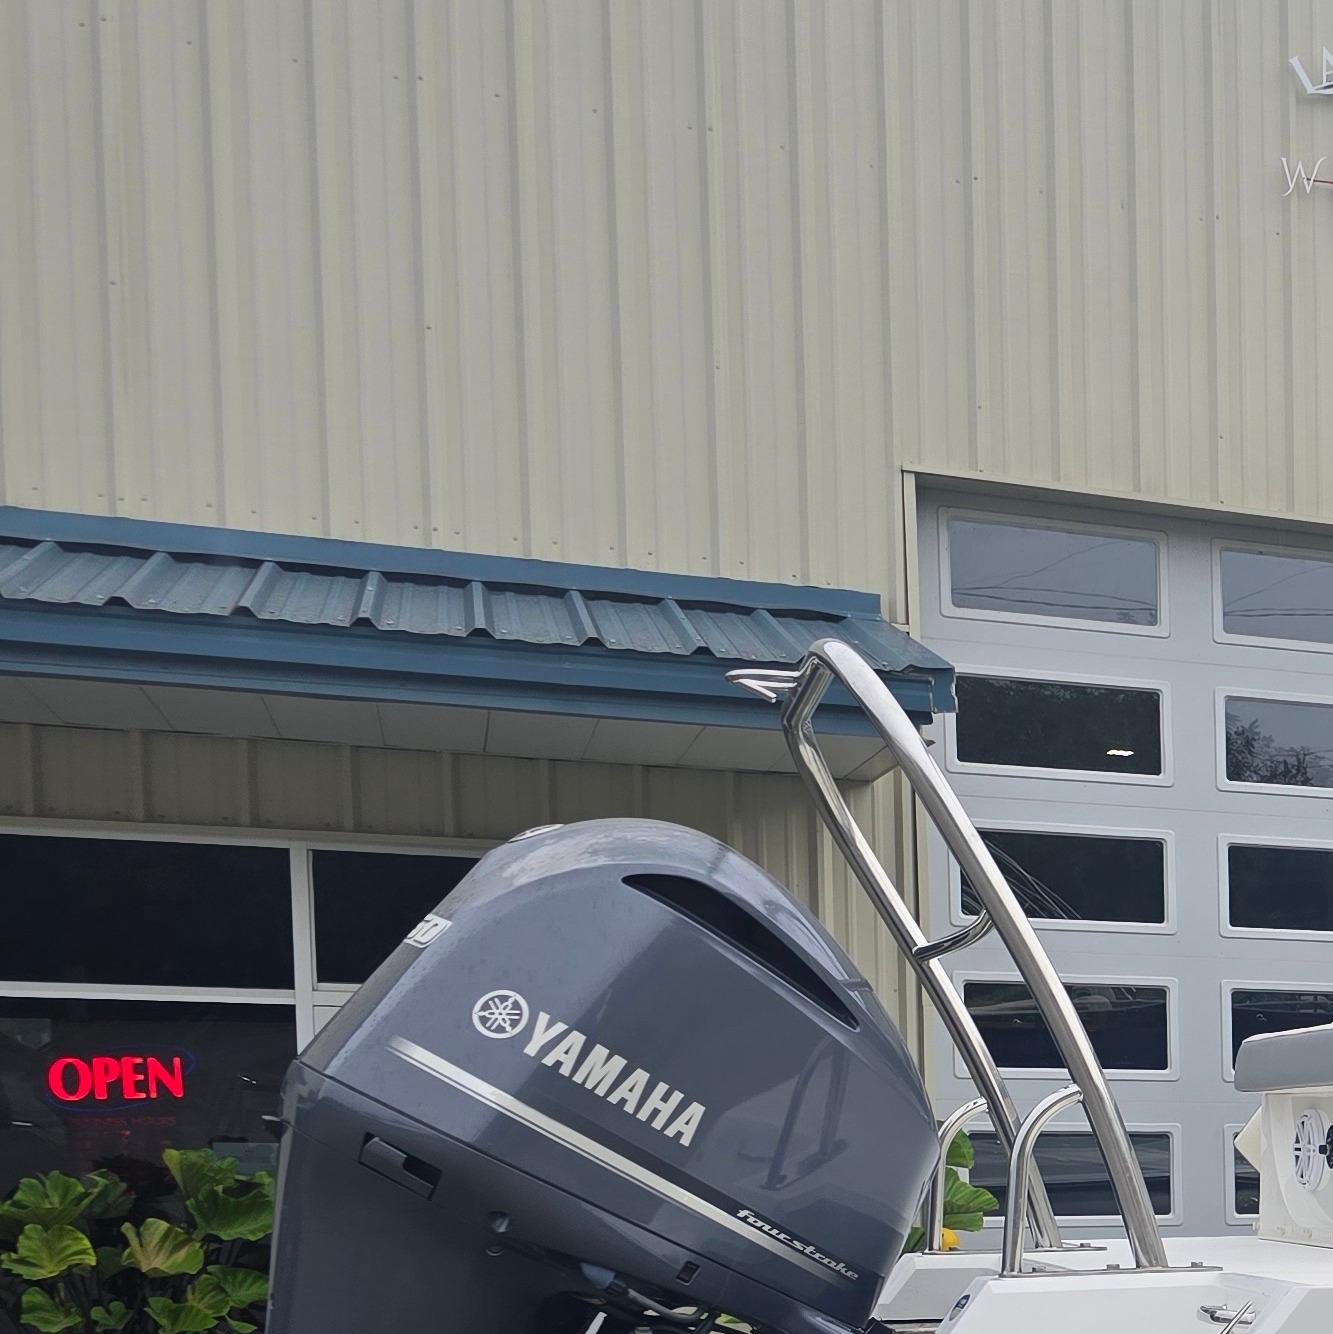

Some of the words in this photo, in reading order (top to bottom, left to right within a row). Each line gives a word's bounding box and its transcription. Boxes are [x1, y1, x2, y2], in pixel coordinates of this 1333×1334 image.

[1280, 156, 1327, 197] W
[48, 1056, 183, 1101] OPEN
[522, 1011, 706, 1147] YAMAHA
